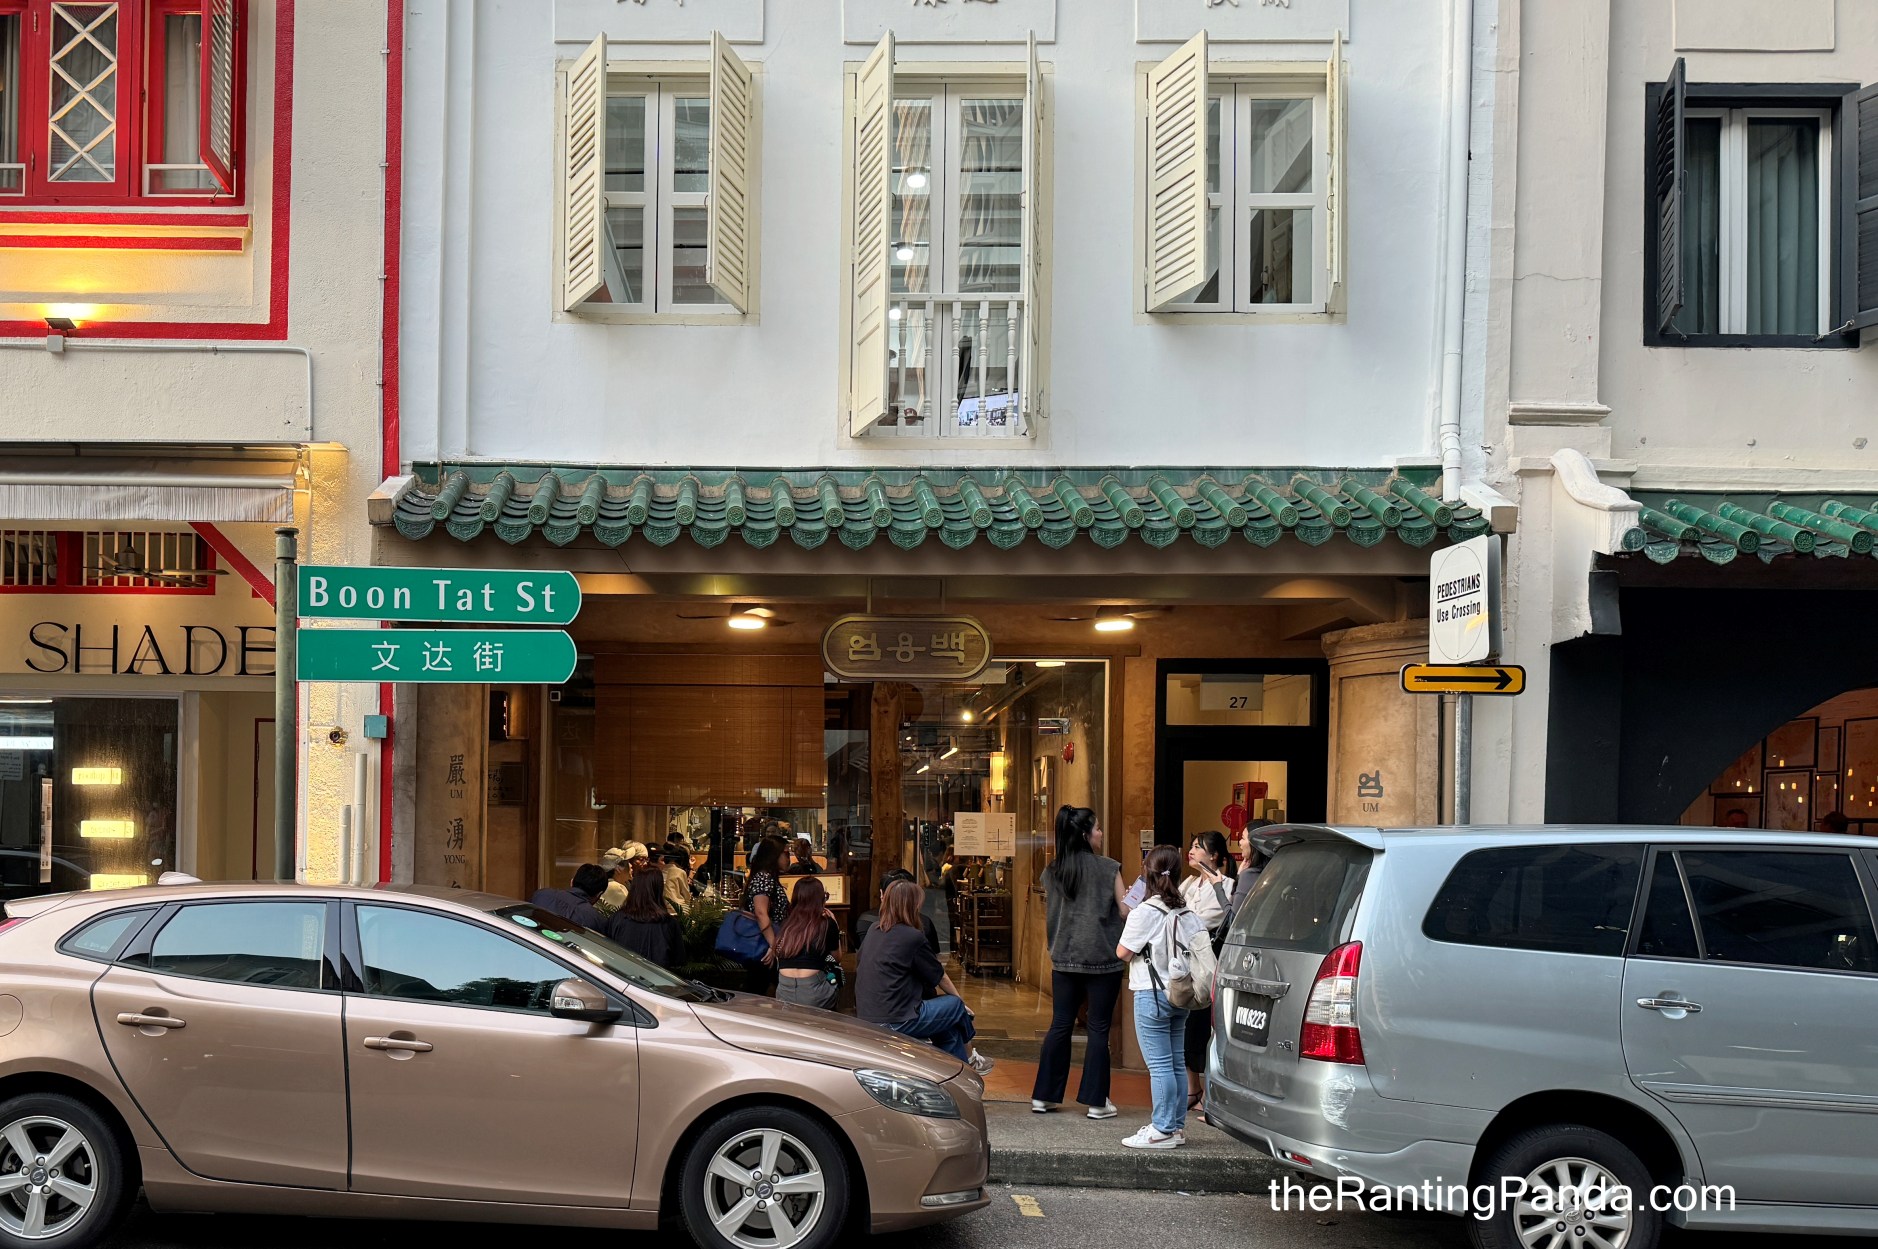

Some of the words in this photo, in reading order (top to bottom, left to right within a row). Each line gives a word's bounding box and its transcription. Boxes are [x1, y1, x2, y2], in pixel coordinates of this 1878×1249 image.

[309, 576, 411, 609] Boon
[432, 579, 496, 612] Tat
[516, 581, 556, 613] St
[1437, 573, 1481, 600] PEDESTRIANS
[1436, 608, 1449, 624] Use
[1451, 600, 1481, 620] Crossing
[25, 621, 277, 676] SHADE
[370, 640, 504, 673] 文达街
[847, 631, 966, 665] 엄용백
[1229, 696, 1248, 709] 27
[445, 753, 467, 786] 嚴
[450, 789, 463, 799] UM
[1357, 769, 1384, 798] 엄
[1362, 802, 1380, 813] UM
[443, 854, 466, 864] YONG
[1247, 1009, 1267, 1029] 8223
